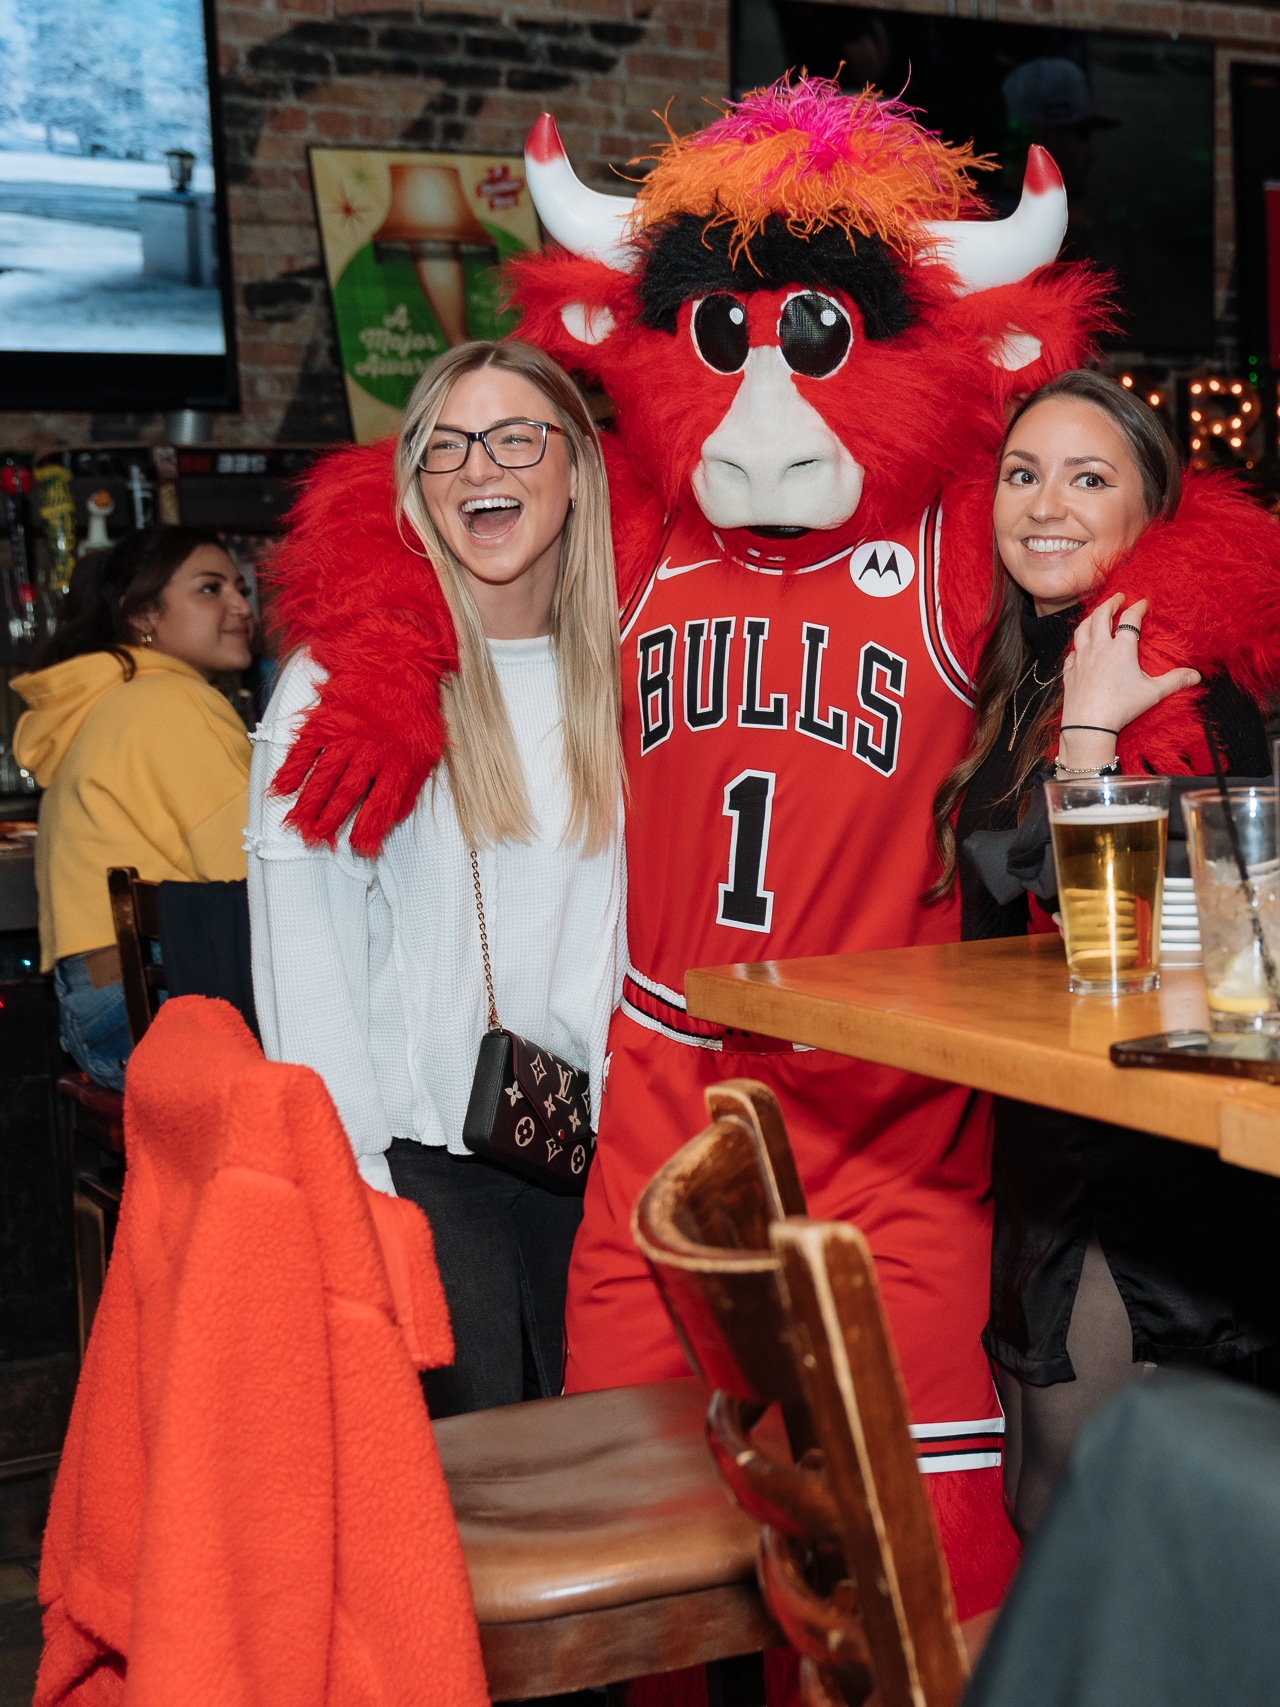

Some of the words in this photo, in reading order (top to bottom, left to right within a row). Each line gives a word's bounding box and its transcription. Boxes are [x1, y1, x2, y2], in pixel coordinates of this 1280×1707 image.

[354, 352, 429, 380] Awar
[637, 616, 907, 779] BULLS
[716, 768, 776, 933] 1
